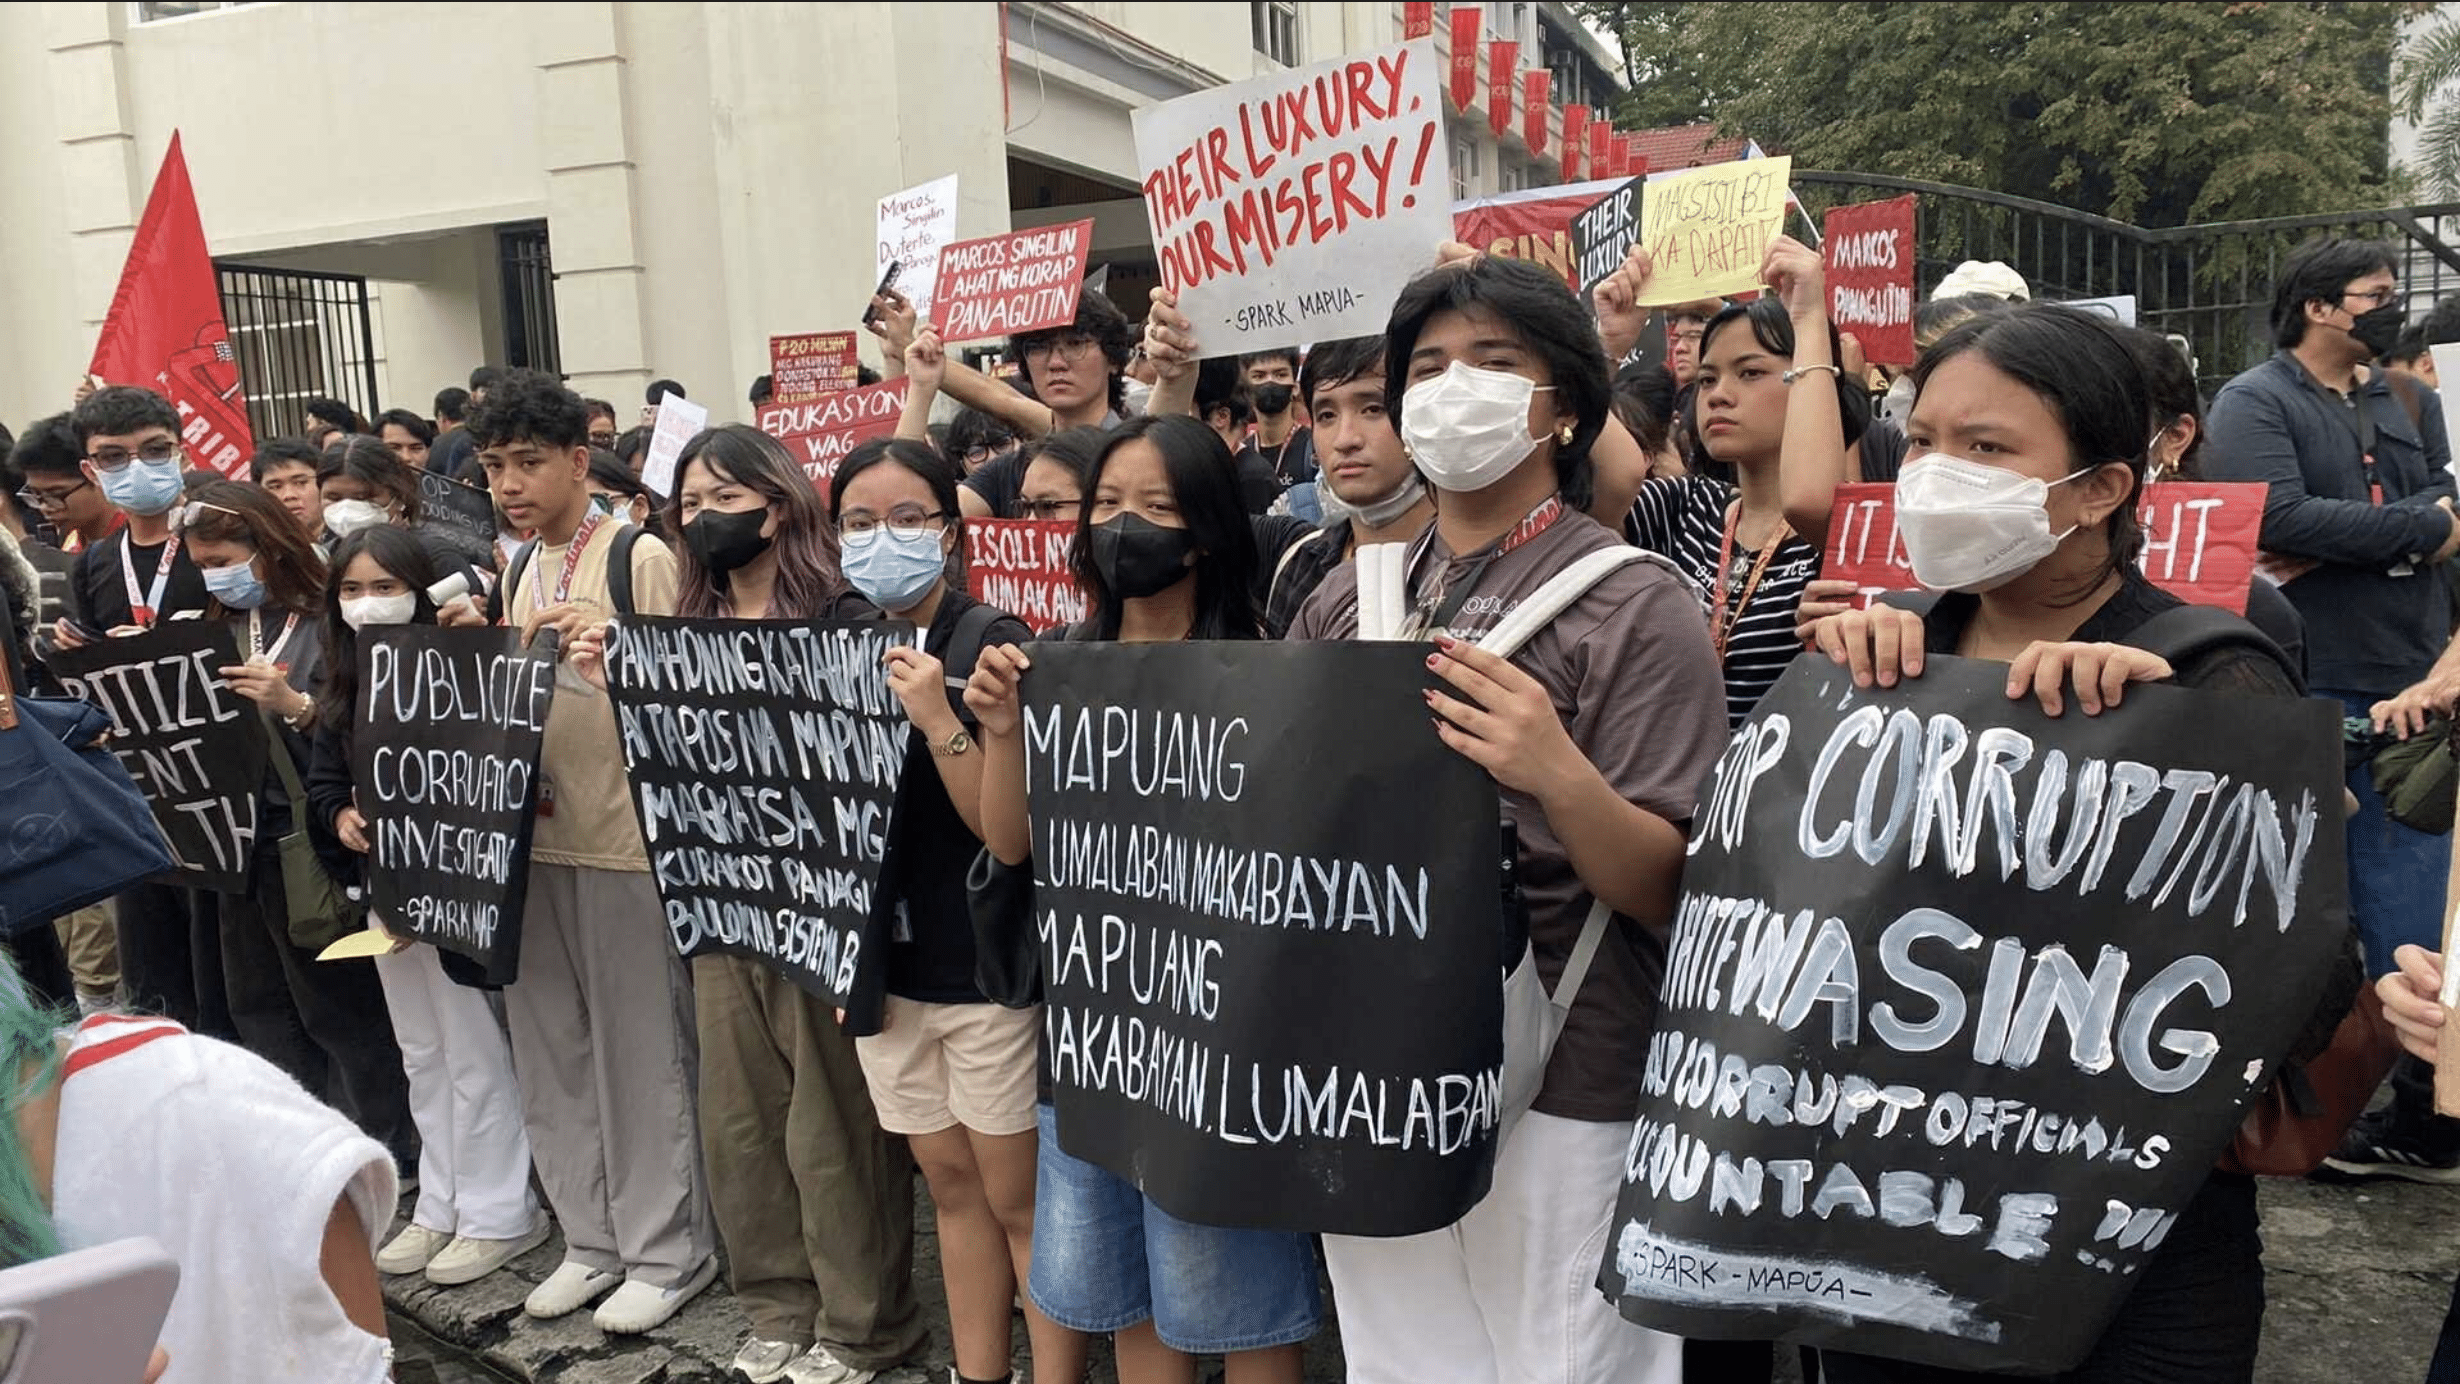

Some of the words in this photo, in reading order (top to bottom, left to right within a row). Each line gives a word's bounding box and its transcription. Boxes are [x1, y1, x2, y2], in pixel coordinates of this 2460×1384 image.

[1143, 127, 1241, 238] THEIR
[1161, 220, 1234, 297] OUR
[1223, 121, 1436, 276] MISERY!
[942, 240, 1006, 275] MARCOS
[1010, 227, 1077, 263] SINGILIN
[1577, 187, 1633, 250] THEIR
[1833, 228, 1898, 271] MARCOS
[937, 268, 998, 303] LAHAT
[996, 265, 1020, 292] NG
[1019, 255, 1077, 288] KORAP
[943, 283, 1076, 337] PANAGUTIN
[1834, 282, 1910, 328] PANAGUTIN
[761, 386, 907, 437] EDUKASYON
[805, 430, 854, 460] WAG
[967, 524, 1041, 572] ISOLI
[1837, 500, 1883, 565] IT
[368, 643, 550, 732] PUBLICIZE
[373, 746, 532, 813] CORRUPTIO
[1022, 704, 1248, 802] MAPUANG
[1797, 704, 2318, 934] CORRUPTION
[1189, 837, 1429, 940] MAKABAYAN
[1035, 908, 1224, 1022] MAPUANG
[1219, 1052, 1505, 1157] LUMALABAN
[1673, 1036, 1927, 1140] CORRUPT
